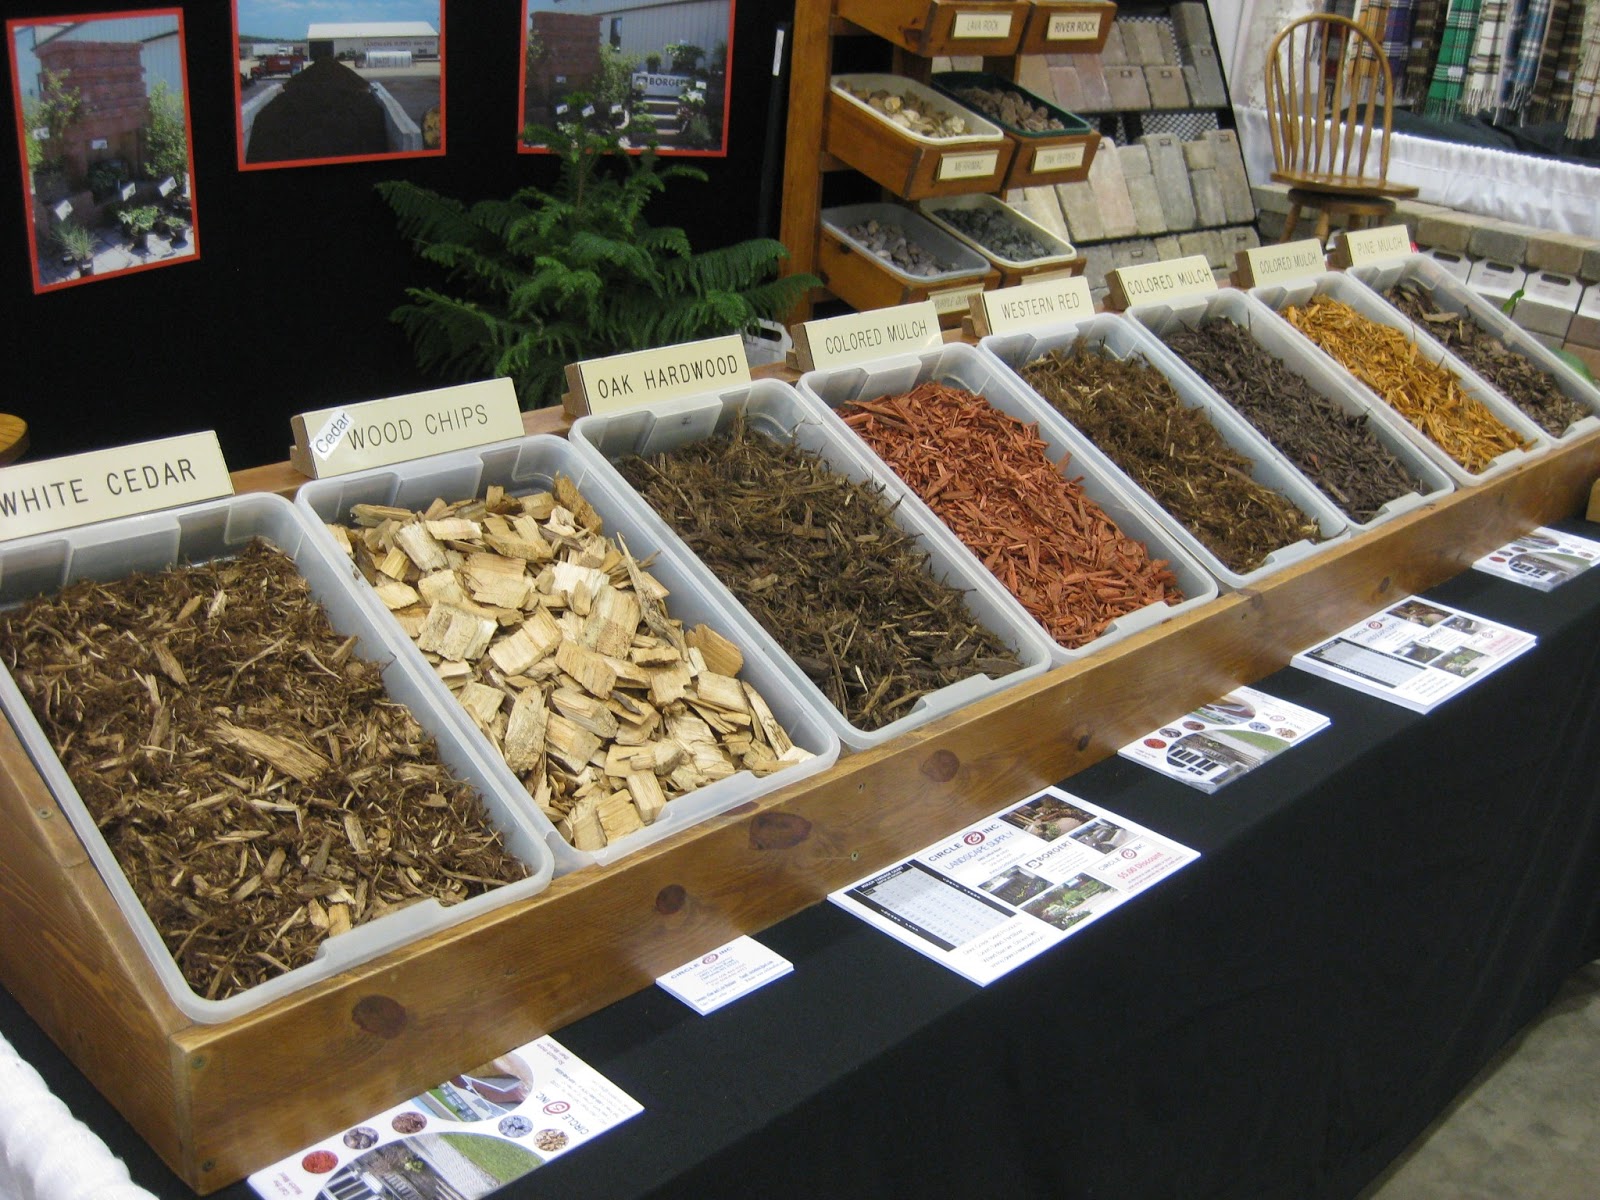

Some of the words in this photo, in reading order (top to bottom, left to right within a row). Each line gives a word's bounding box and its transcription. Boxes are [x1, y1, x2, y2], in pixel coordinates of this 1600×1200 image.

[1054, 21, 1075, 33] RIVER
[1075, 21, 1096, 33] ROCK
[1357, 240, 1374, 256] PINE
[1377, 236, 1403, 253] MULCH
[1259, 256, 1291, 275] COLORED
[1294, 252, 1317, 268] MULCH
[1127, 274, 1174, 295] COLORED
[1177, 268, 1212, 287] MULCH
[1001, 295, 1054, 320] WESTERN
[1058, 292, 1080, 310] RED
[825, 328, 882, 355] COLORED
[886, 319, 928, 343] MULCH
[597, 374, 634, 399] OAK
[643, 354, 738, 390] HARDWOOD
[315, 411, 351, 454] Cedar
[347, 418, 413, 450] WOOD
[425, 404, 488, 435] CHIPS
[0, 478, 89, 518] WHITE
[106, 458, 197, 495] CEDAR
[928, 842, 963, 862] CIRCLE
[982, 823, 1003, 834] INC.
[944, 844, 988, 870] LANDSCAPE
[986, 830, 1015, 851] SUPPLY
[1036, 839, 1073, 862] BORGERT
[1098, 856, 1122, 871] CIRCLE
[671, 962, 700, 979] CIRCLE
[562, 1113, 590, 1135] CIRCLE
